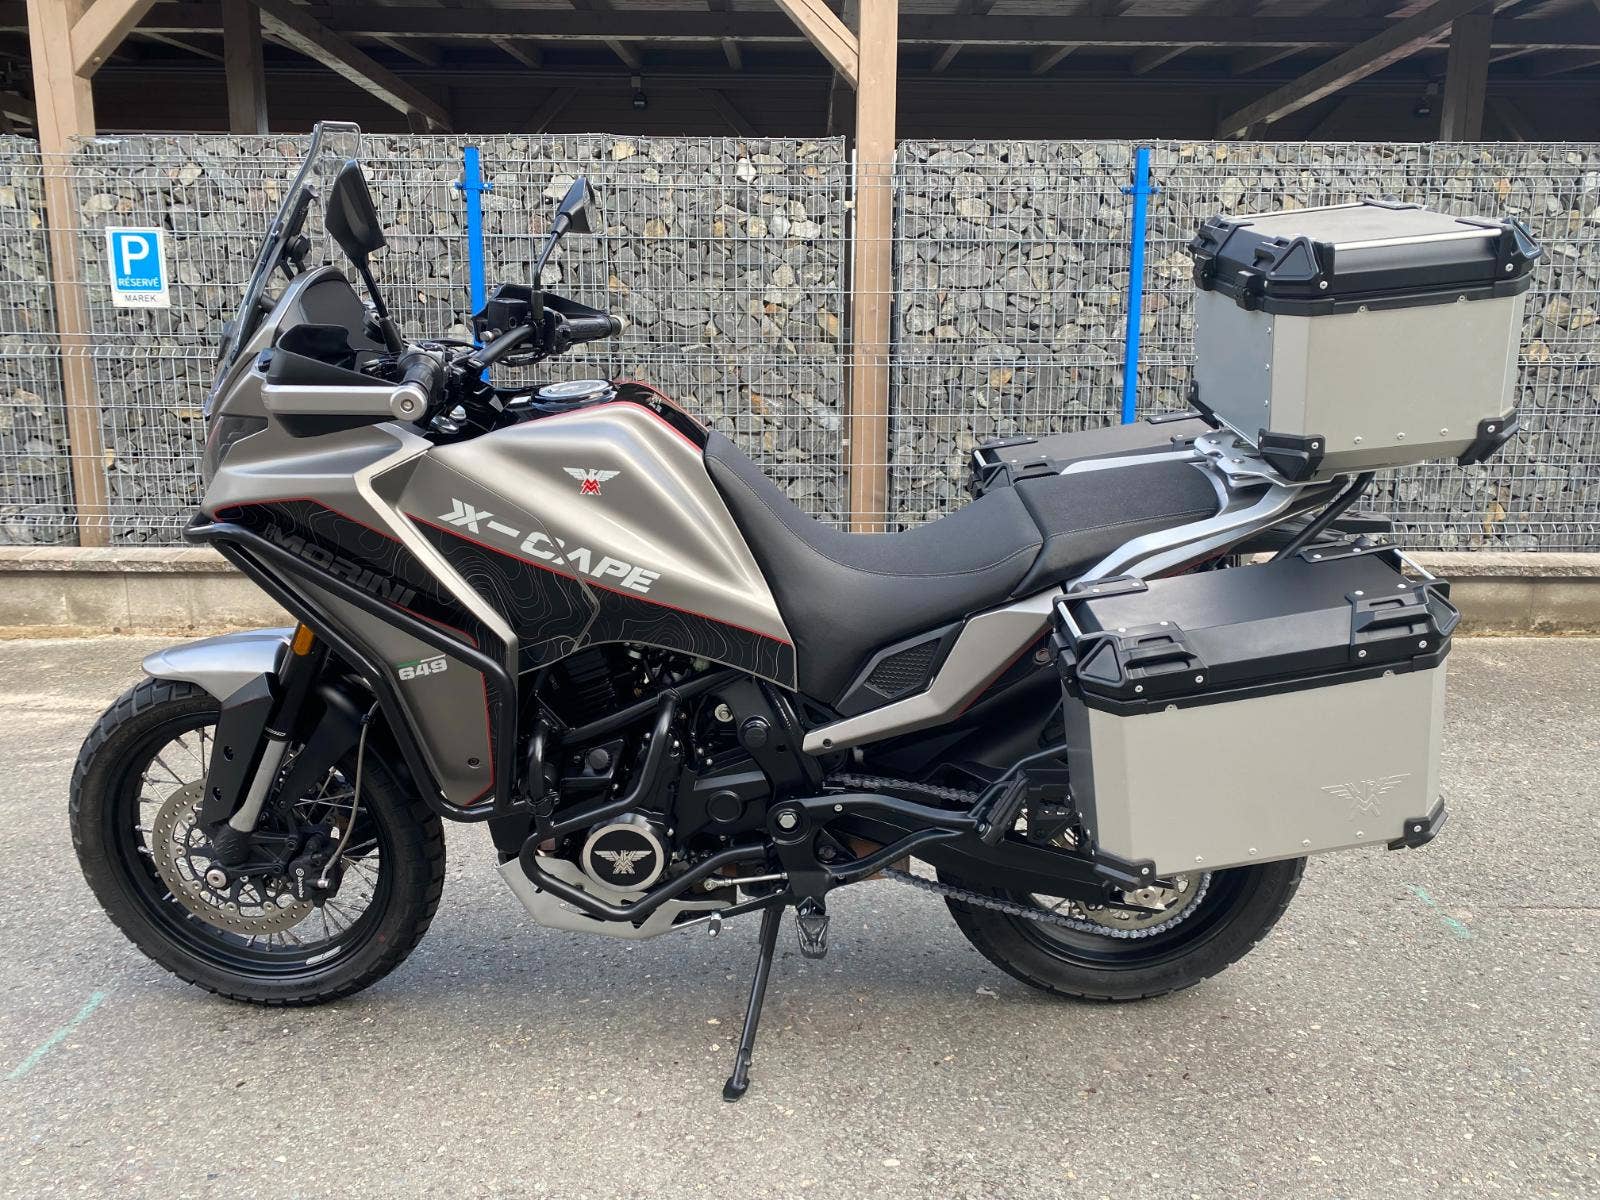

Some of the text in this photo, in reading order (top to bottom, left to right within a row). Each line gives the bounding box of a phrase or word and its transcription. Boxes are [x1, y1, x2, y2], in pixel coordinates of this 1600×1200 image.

[121, 235, 150, 275] P
[118, 276, 160, 287] RÉSERVÉ
[125, 294, 157, 302] MAREK
[437, 498, 661, 594] X-CAPE
[273, 525, 417, 608] MORINI
[399, 659, 447, 680] 649
